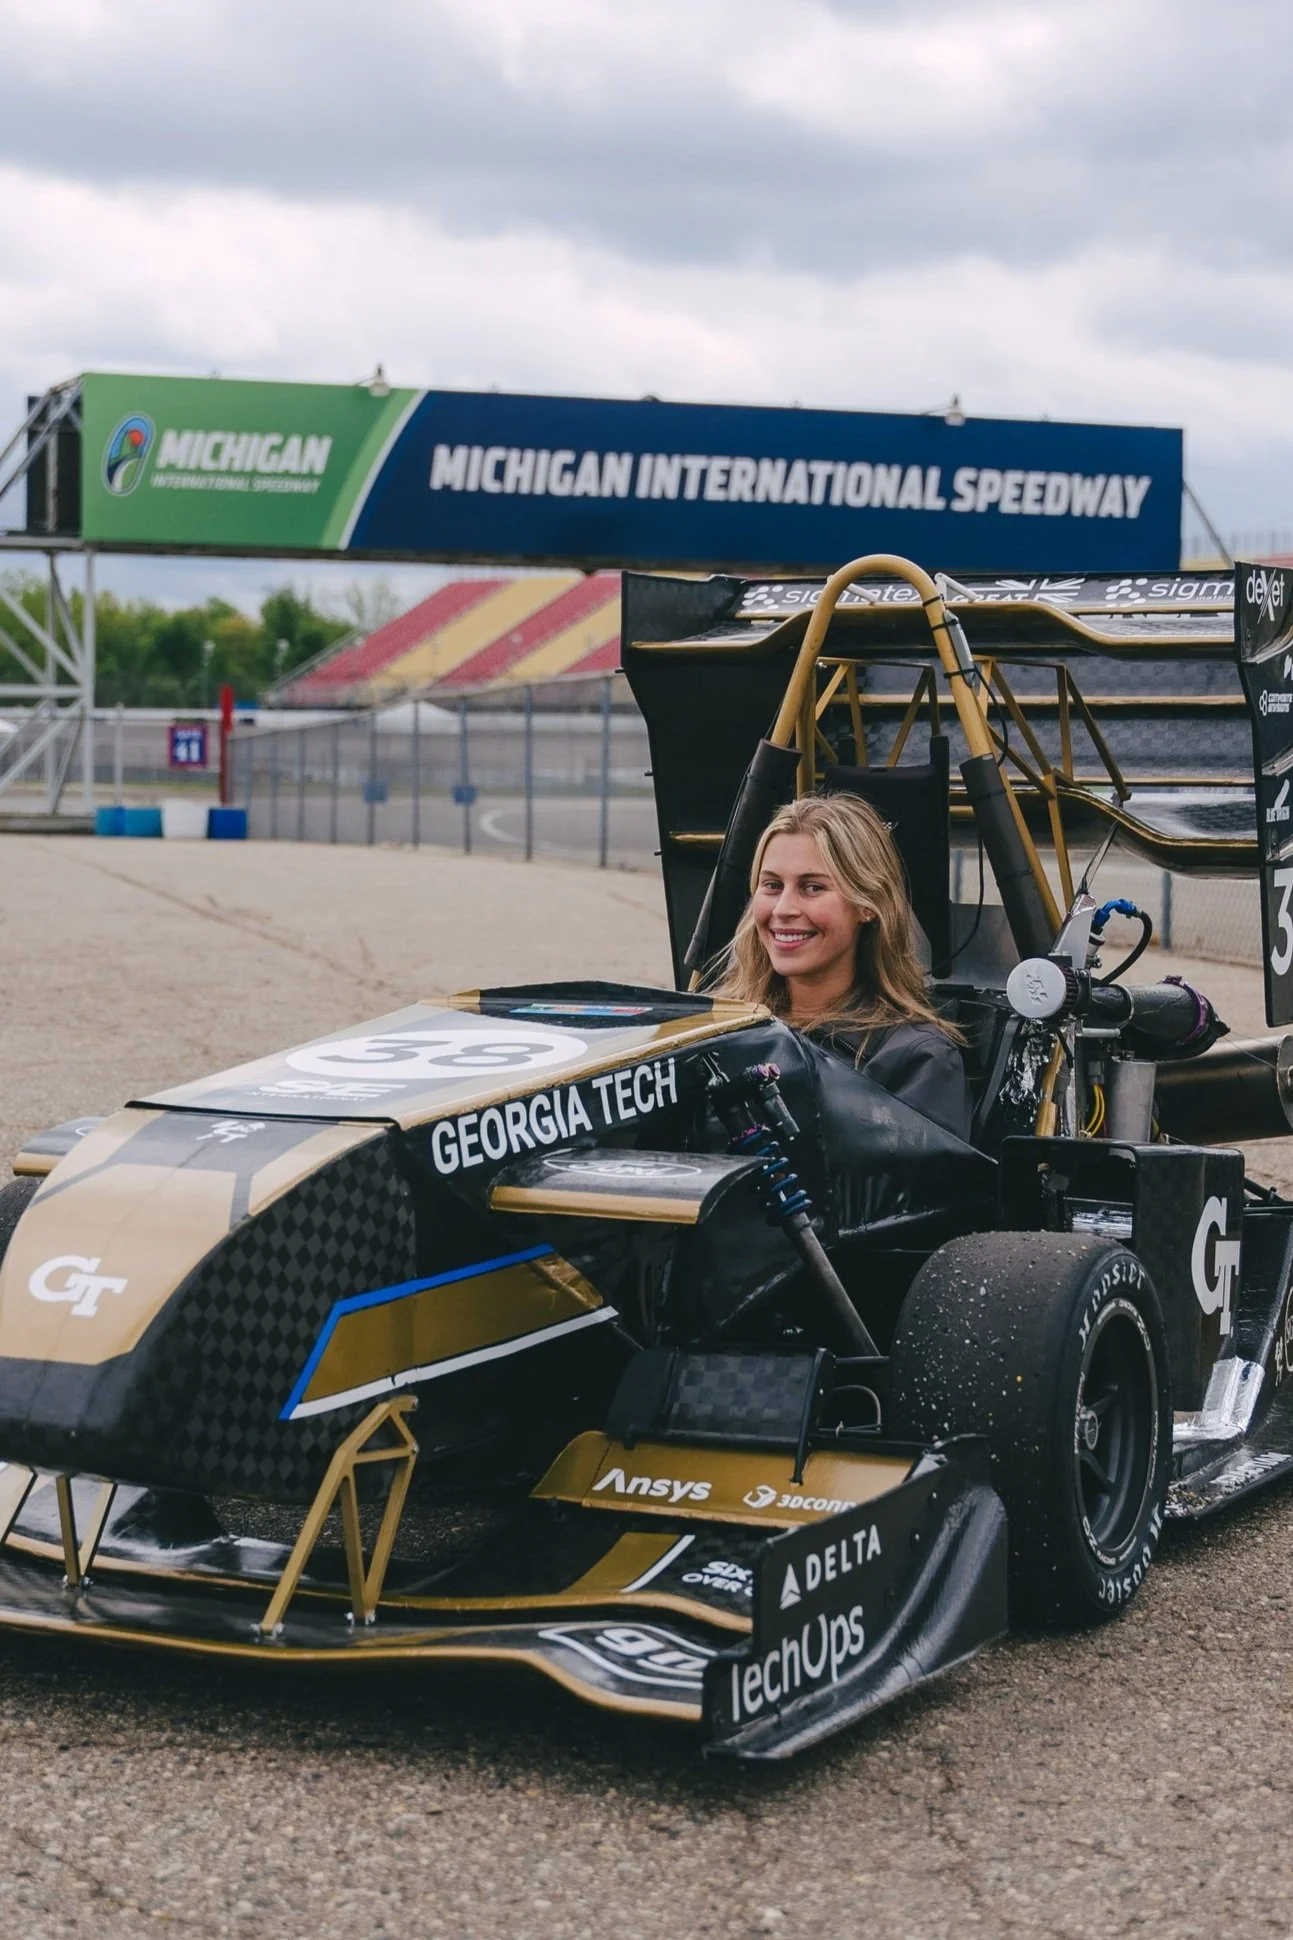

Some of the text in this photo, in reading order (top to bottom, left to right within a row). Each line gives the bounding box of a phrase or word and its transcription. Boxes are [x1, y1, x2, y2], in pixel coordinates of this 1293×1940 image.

[156, 428, 333, 474] MICHIGAN
[429, 443, 1152, 520] MICHIGAN INTERNATIONAL SPEEDWAY
[317, 1038, 556, 1068] 38
[431, 1058, 678, 1175] GEORGIA TECH
[28, 1255, 128, 1317] GT
[592, 1468, 713, 1503] Ansys
[805, 1525, 882, 1592] DELTA
